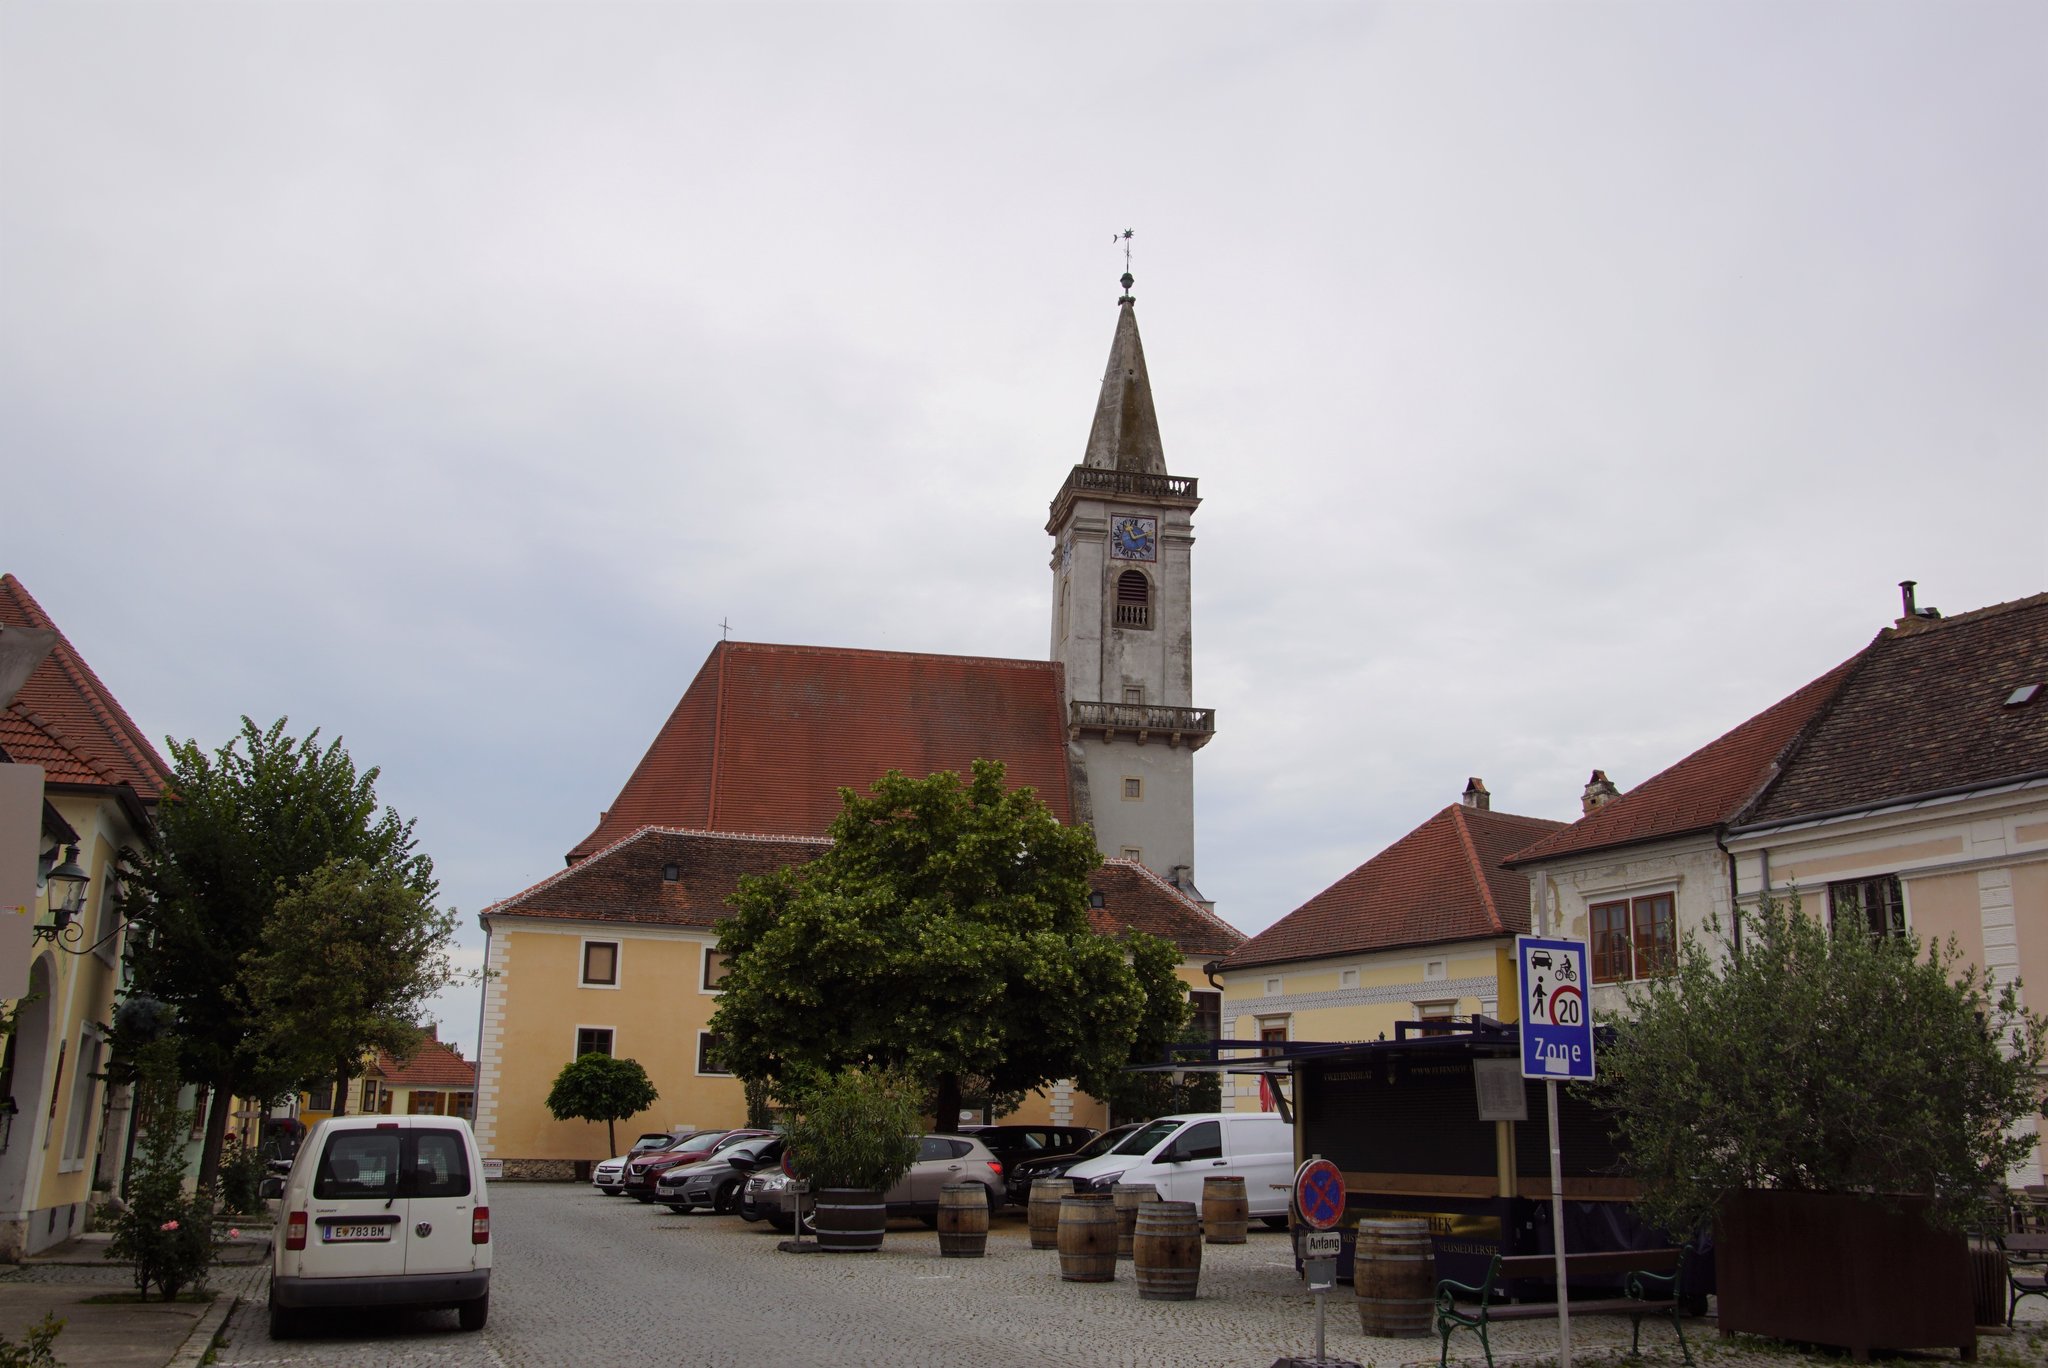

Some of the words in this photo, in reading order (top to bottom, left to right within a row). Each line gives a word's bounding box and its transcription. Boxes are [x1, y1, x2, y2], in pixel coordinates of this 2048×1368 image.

[1558, 999, 1579, 1024] 20
[1534, 1037, 1582, 1062] Zone
[1309, 1236, 1340, 1251] Anfang
